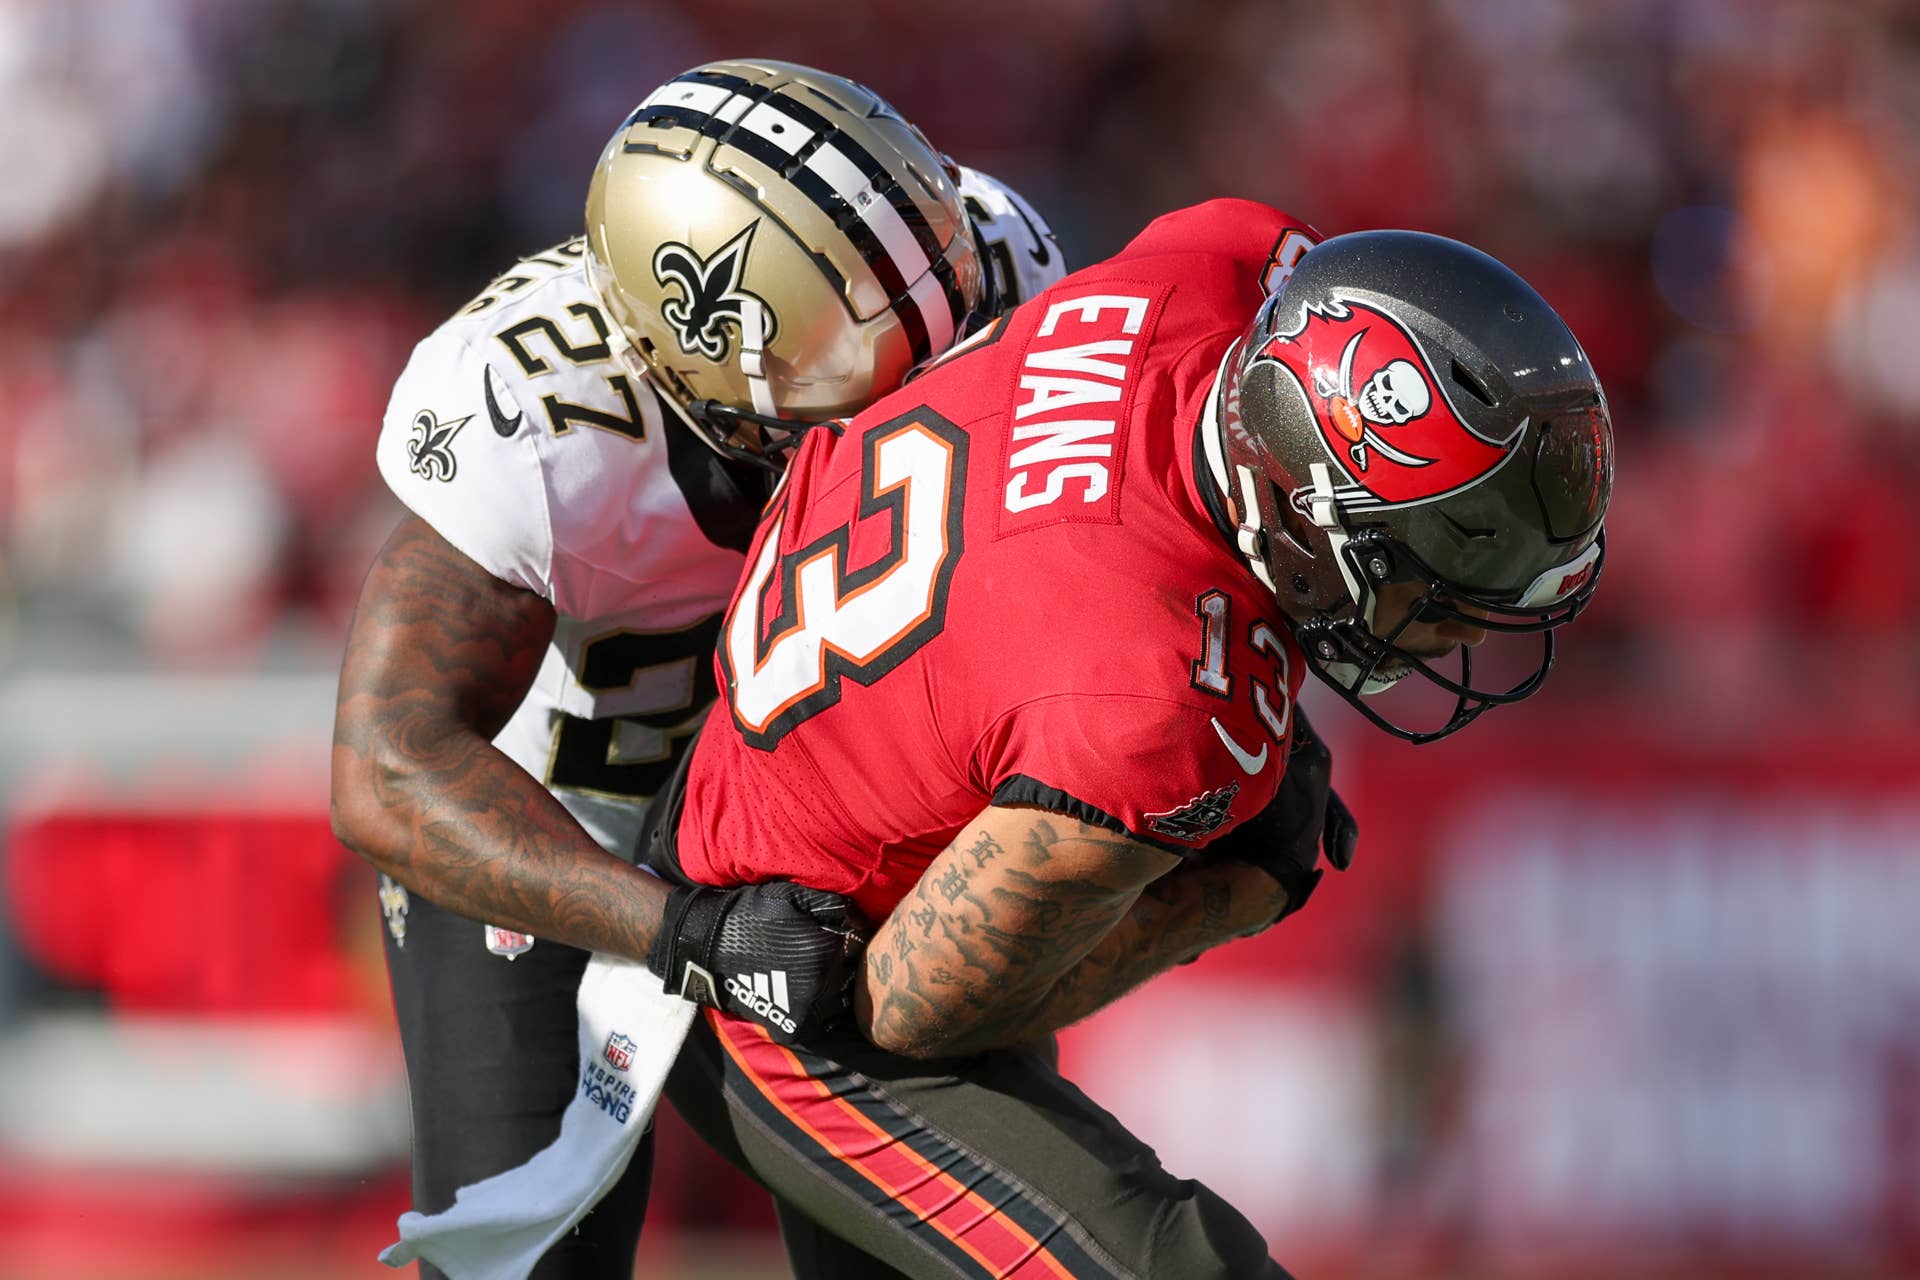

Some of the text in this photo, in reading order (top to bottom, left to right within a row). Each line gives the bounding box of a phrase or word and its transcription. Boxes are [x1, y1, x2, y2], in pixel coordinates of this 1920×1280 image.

[495, 302, 648, 443] 27
[1002, 294, 1151, 514] EVANS
[716, 314, 1014, 753] 3
[1189, 587, 1289, 746] 13
[606, 1044, 630, 1070] NFL
[723, 978, 797, 1034] adidas
